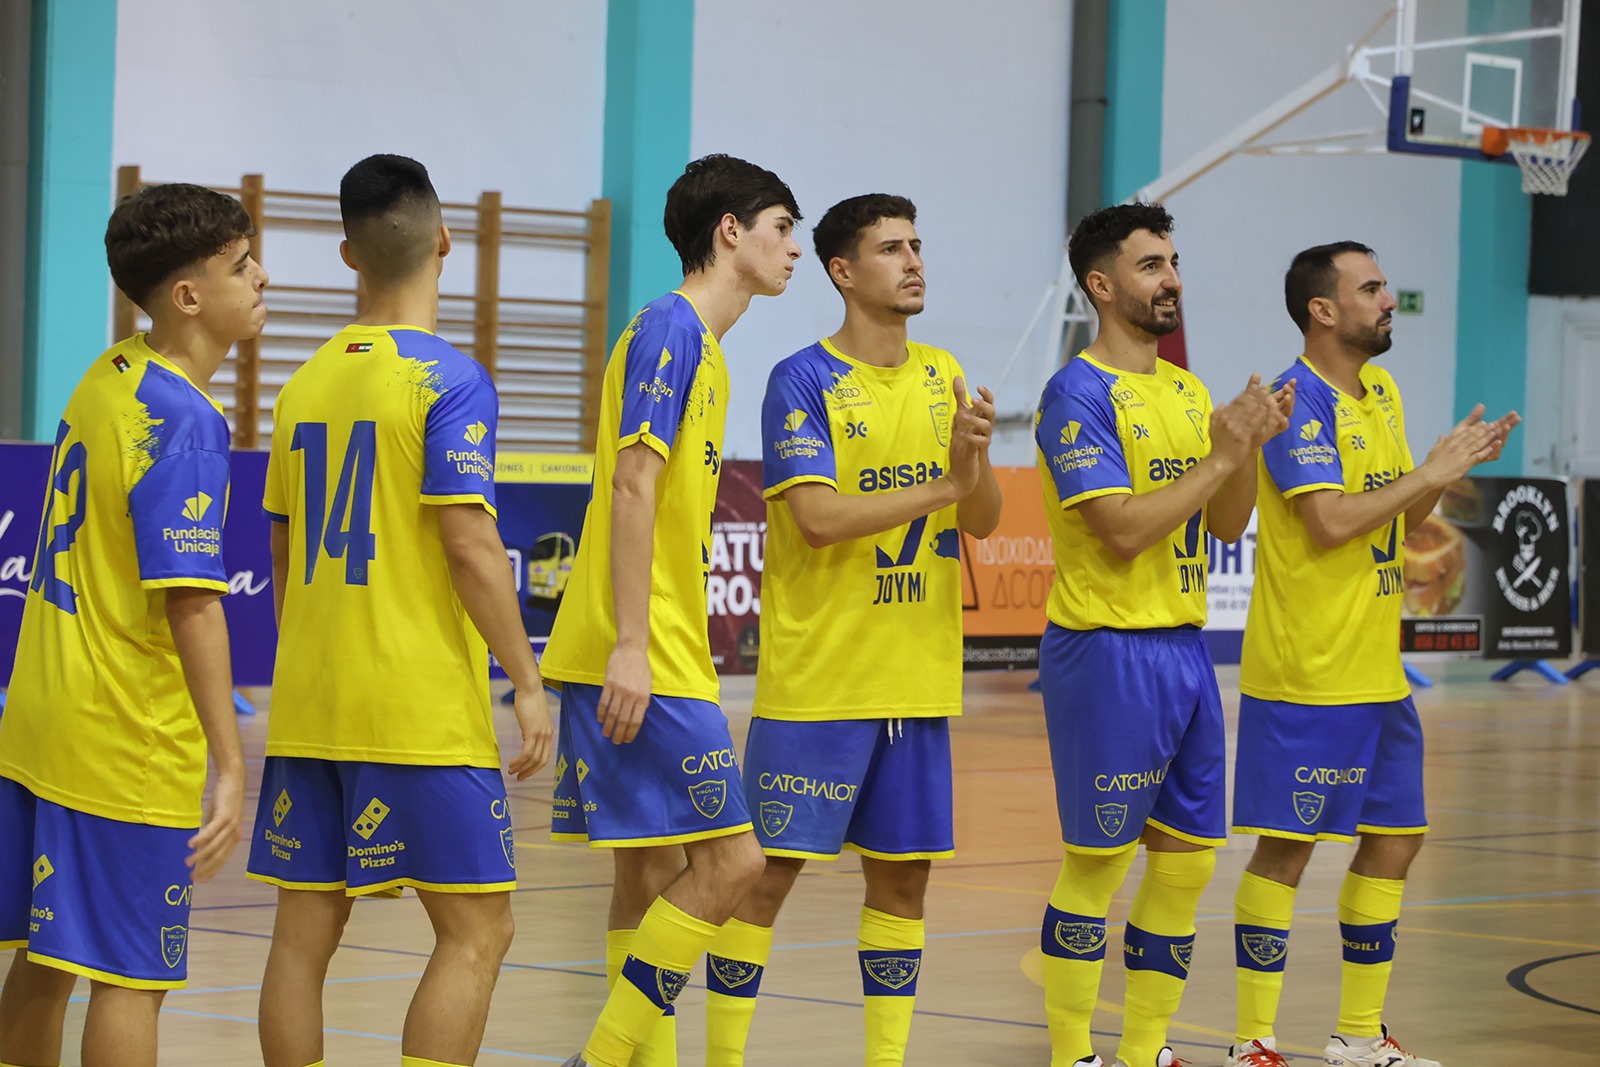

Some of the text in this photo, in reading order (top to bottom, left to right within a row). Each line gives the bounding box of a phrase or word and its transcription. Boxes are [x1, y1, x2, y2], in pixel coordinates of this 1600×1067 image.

[774, 435, 826, 452] Fundación
[780, 446, 818, 460] Unicaja
[1054, 444, 1104, 466] Fundación
[1061, 456, 1098, 473] Unicaja
[290, 420, 376, 586] 14
[174, 539, 220, 557] Unicaja
[759, 772, 858, 802] CATCHALOT
[265, 829, 302, 850] Domino's
[271, 845, 291, 861] Pizza
[348, 840, 405, 857] Domino's
[360, 856, 396, 869] Pizza
